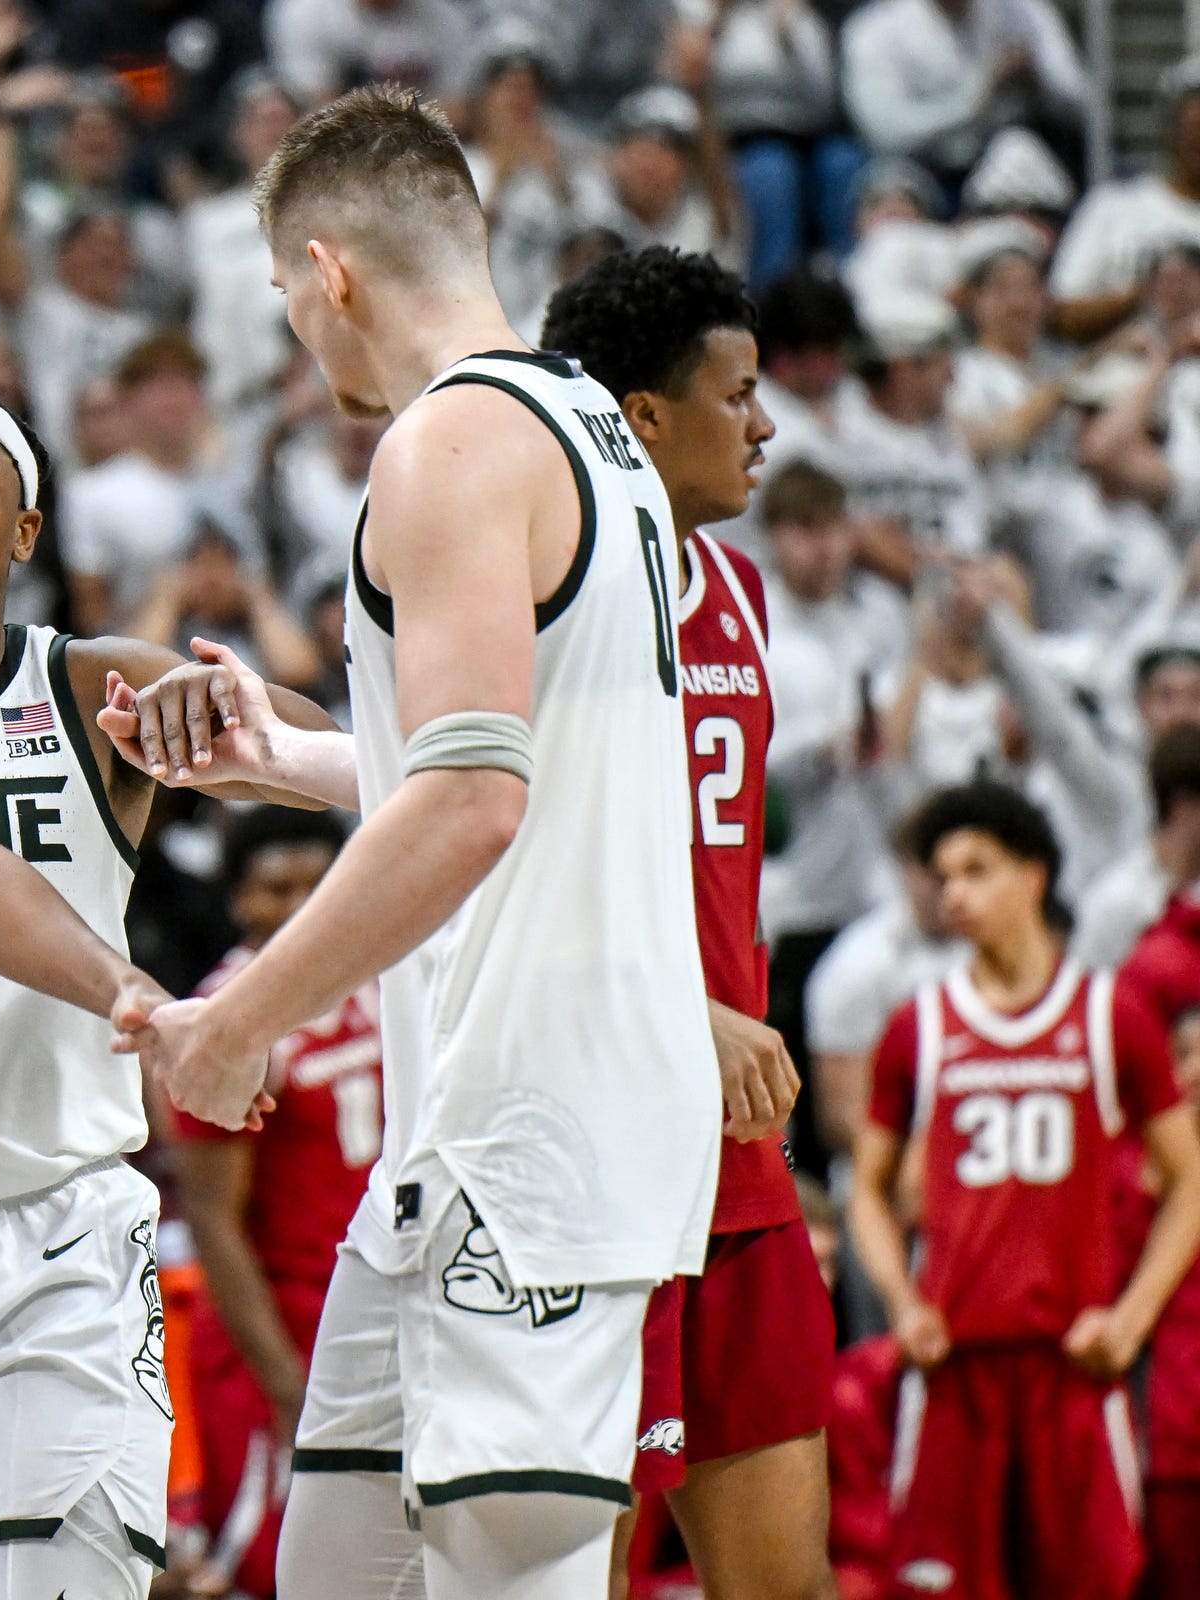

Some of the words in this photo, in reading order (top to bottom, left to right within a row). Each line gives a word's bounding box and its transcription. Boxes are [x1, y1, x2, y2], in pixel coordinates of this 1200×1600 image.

[634, 505, 678, 698] 0
[680, 663, 760, 697] ANSAS
[693, 715, 747, 847] 2
[953, 1093, 1075, 1187] 30
